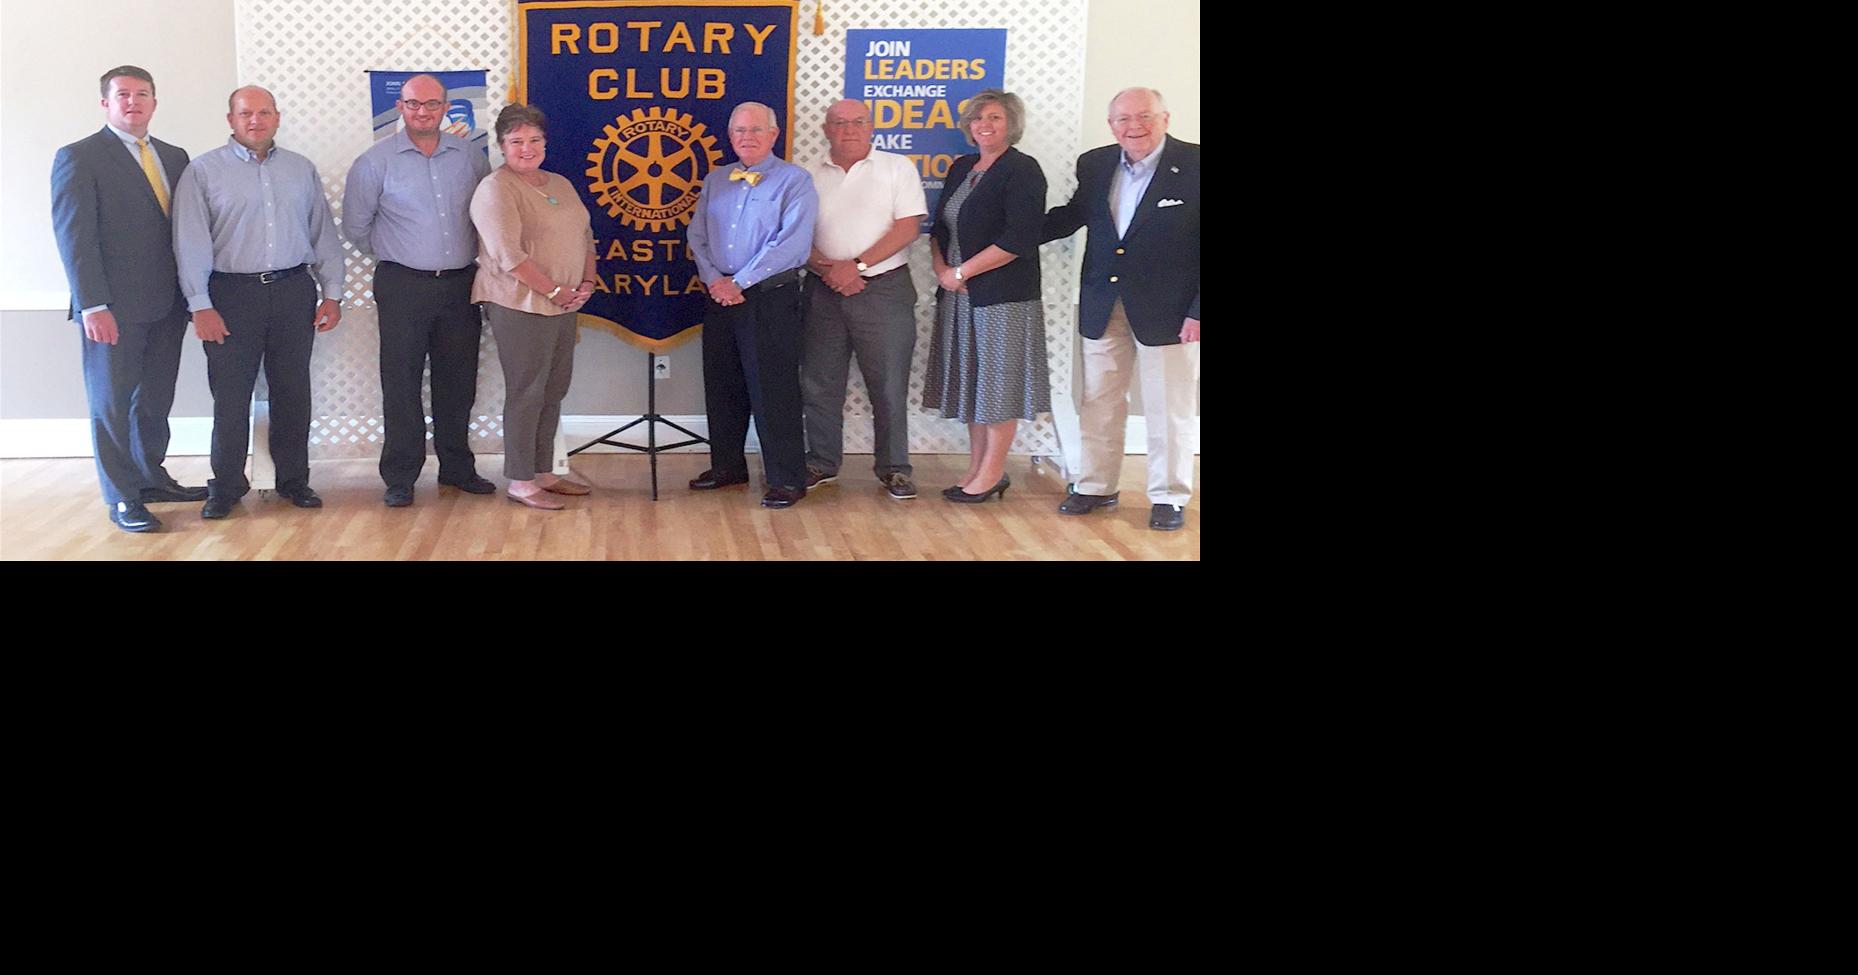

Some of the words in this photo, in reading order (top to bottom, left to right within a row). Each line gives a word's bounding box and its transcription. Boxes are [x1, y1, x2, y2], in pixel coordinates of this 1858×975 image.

[551, 22, 777, 55] ROTARY
[866, 40, 911, 57] JOIN
[864, 59, 986, 80] LEADERS
[588, 68, 726, 100] CLUB
[864, 85, 947, 97] EXCHANGE
[621, 120, 690, 139] ROTARY
[609, 189, 701, 219] INTERNATIONAL
